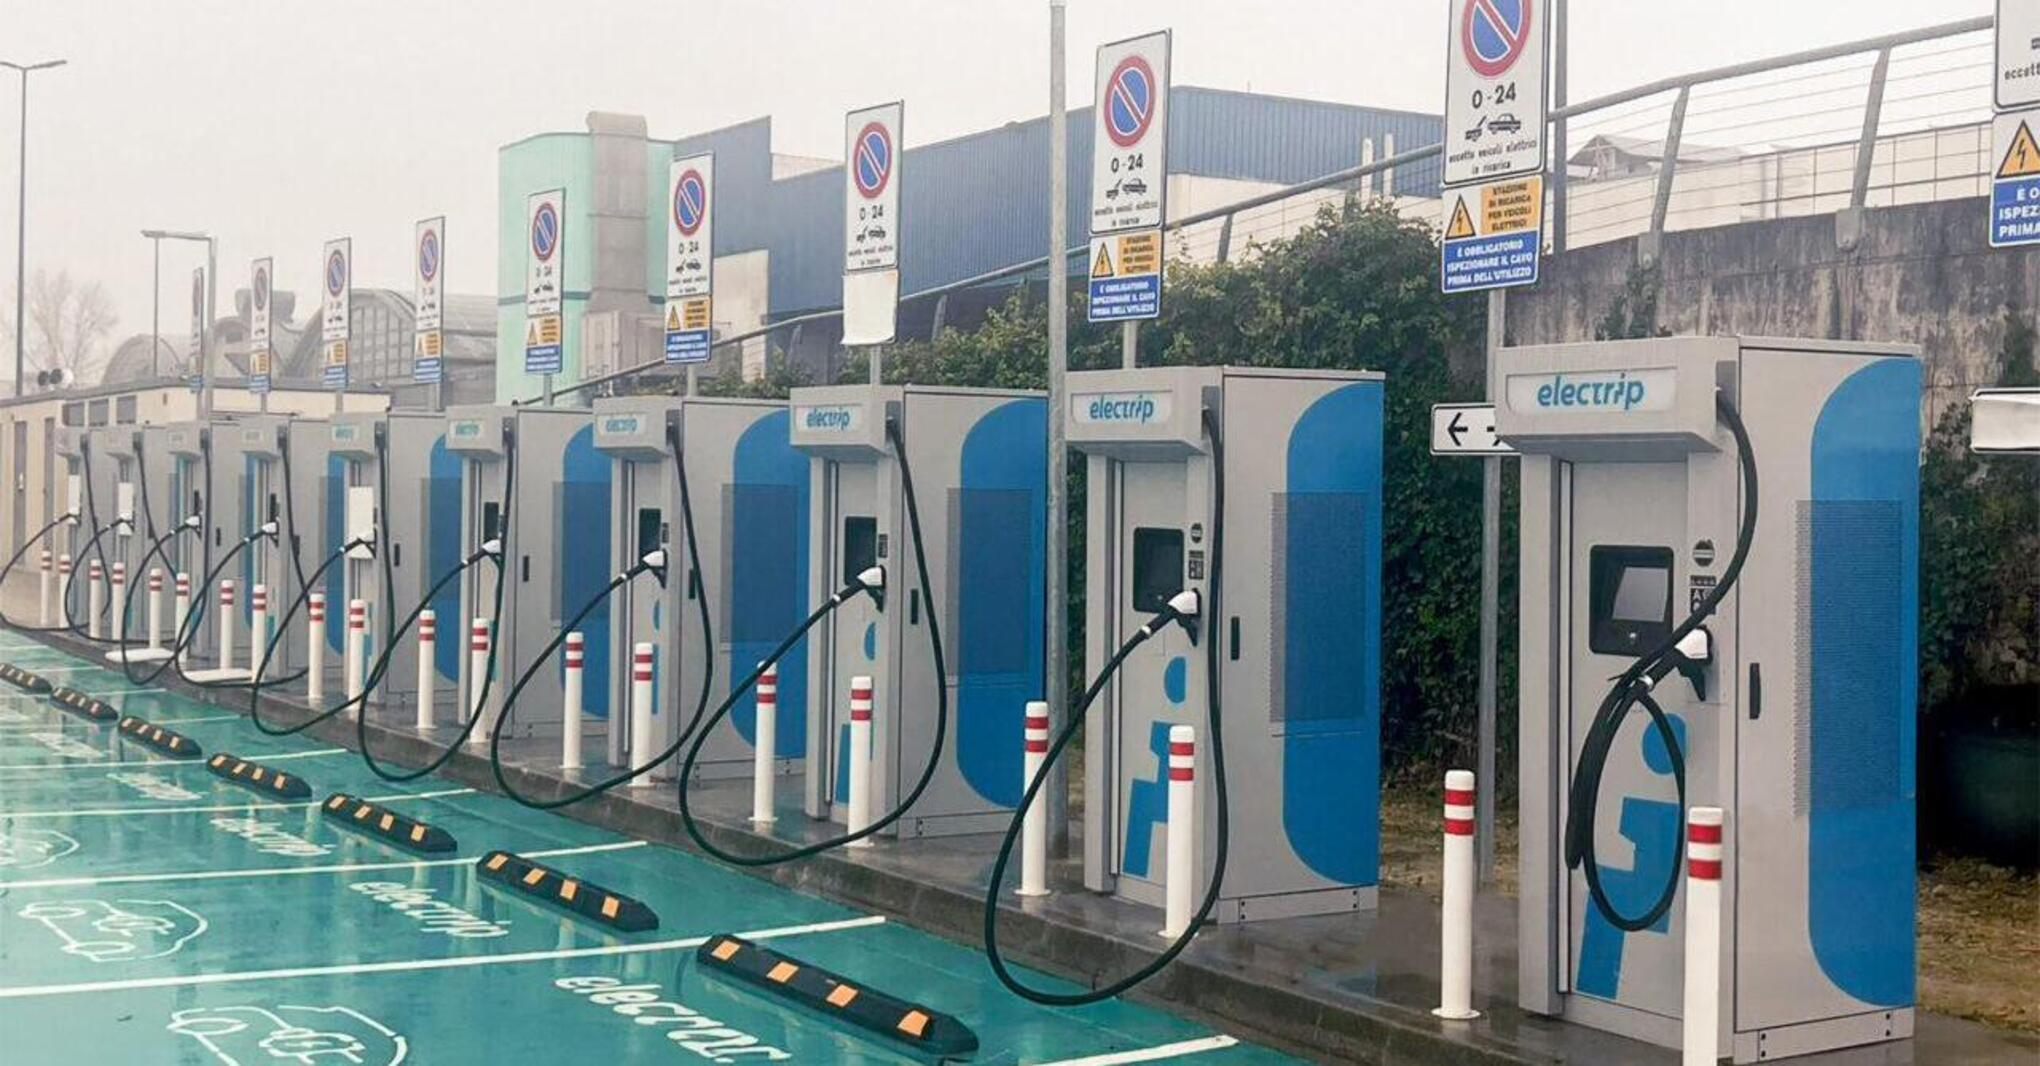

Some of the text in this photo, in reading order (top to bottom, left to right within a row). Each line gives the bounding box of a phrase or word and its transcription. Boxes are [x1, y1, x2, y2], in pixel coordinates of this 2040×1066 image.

[1472, 89, 1483, 109] 0
[1495, 81, 1516, 105] 24
[1111, 157, 1119, 173] 0
[1128, 153, 1143, 171] 24
[1537, 372, 1644, 411] electrip
[1090, 394, 1154, 424] electrip
